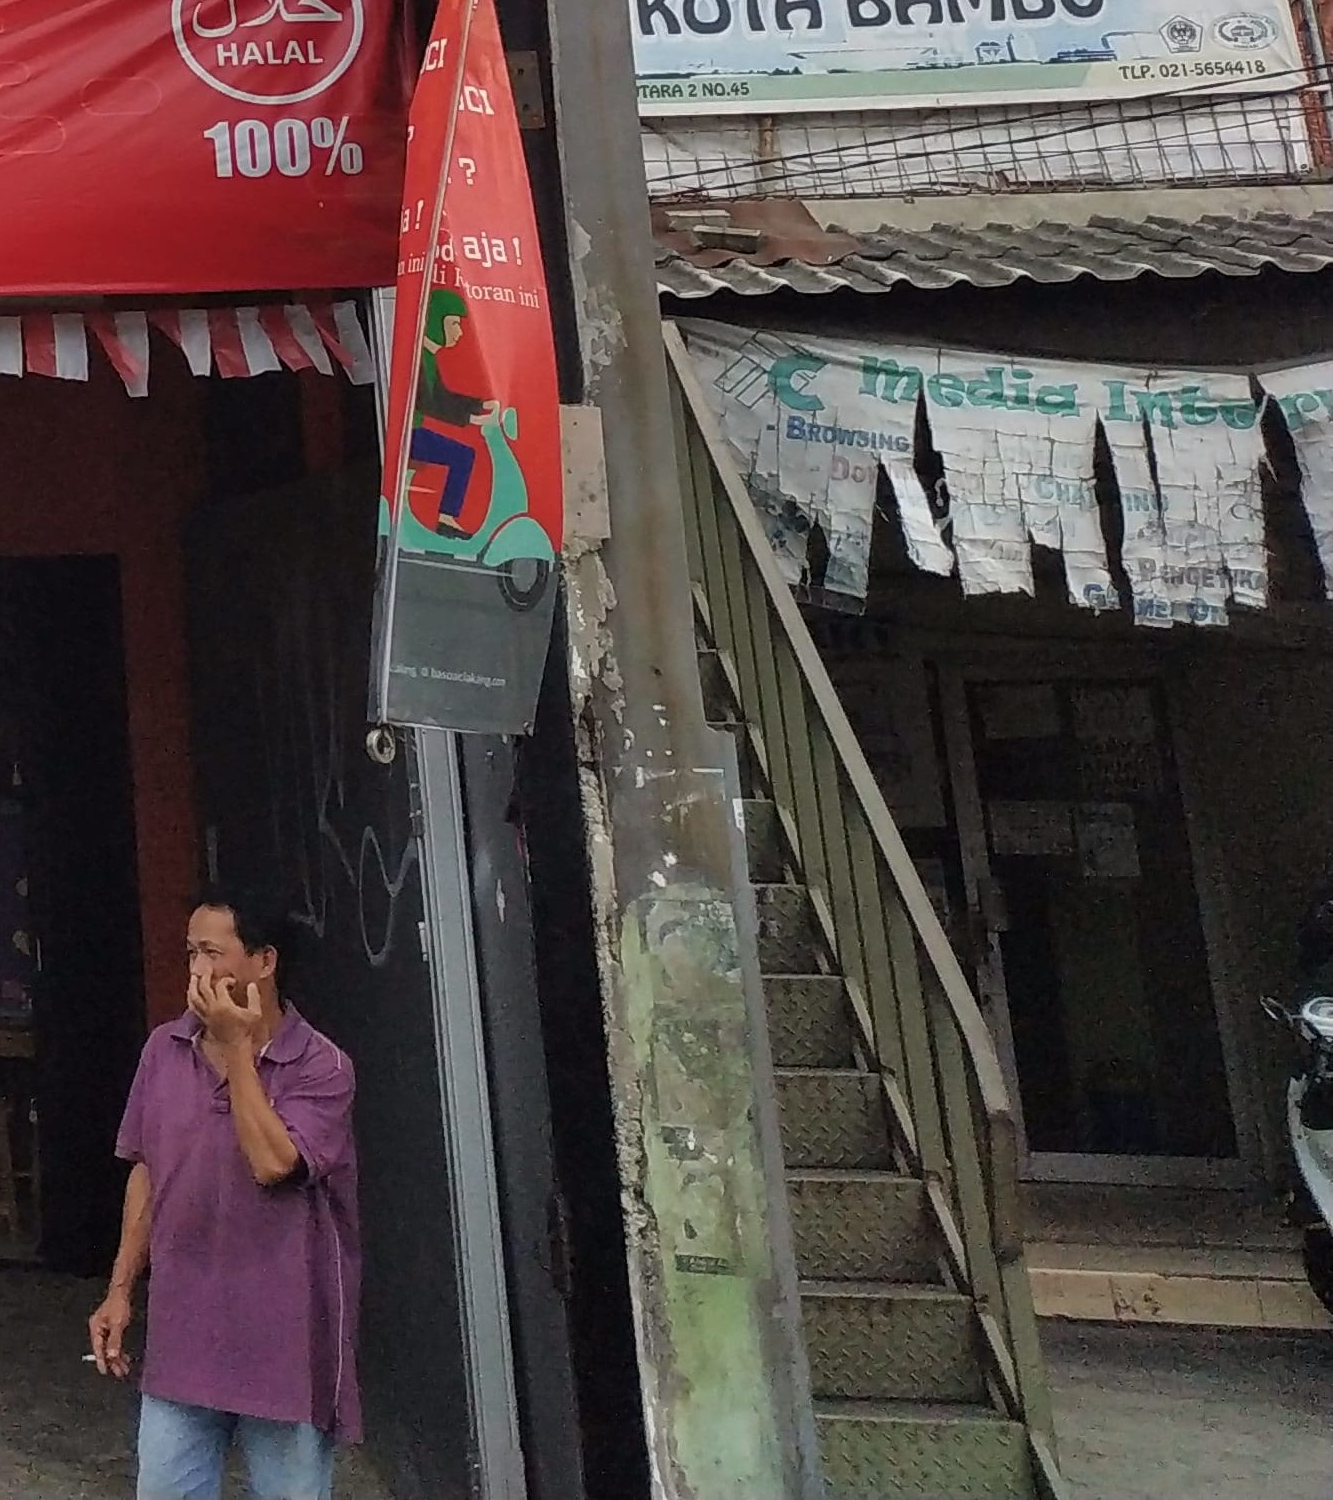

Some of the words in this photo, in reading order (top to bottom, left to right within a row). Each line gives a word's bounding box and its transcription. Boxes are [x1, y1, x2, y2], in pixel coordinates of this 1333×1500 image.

[216, 39, 325, 67] HALAL
[1118, 65, 1156, 81] TLP.
[1159, 59, 1267, 78] 021-5654418
[688, 83, 699, 98] 2
[702, 82, 751, 98] NO.45
[202, 115, 364, 178] 100%
[462, 232, 508, 268] aja
[518, 286, 540, 310] ini
